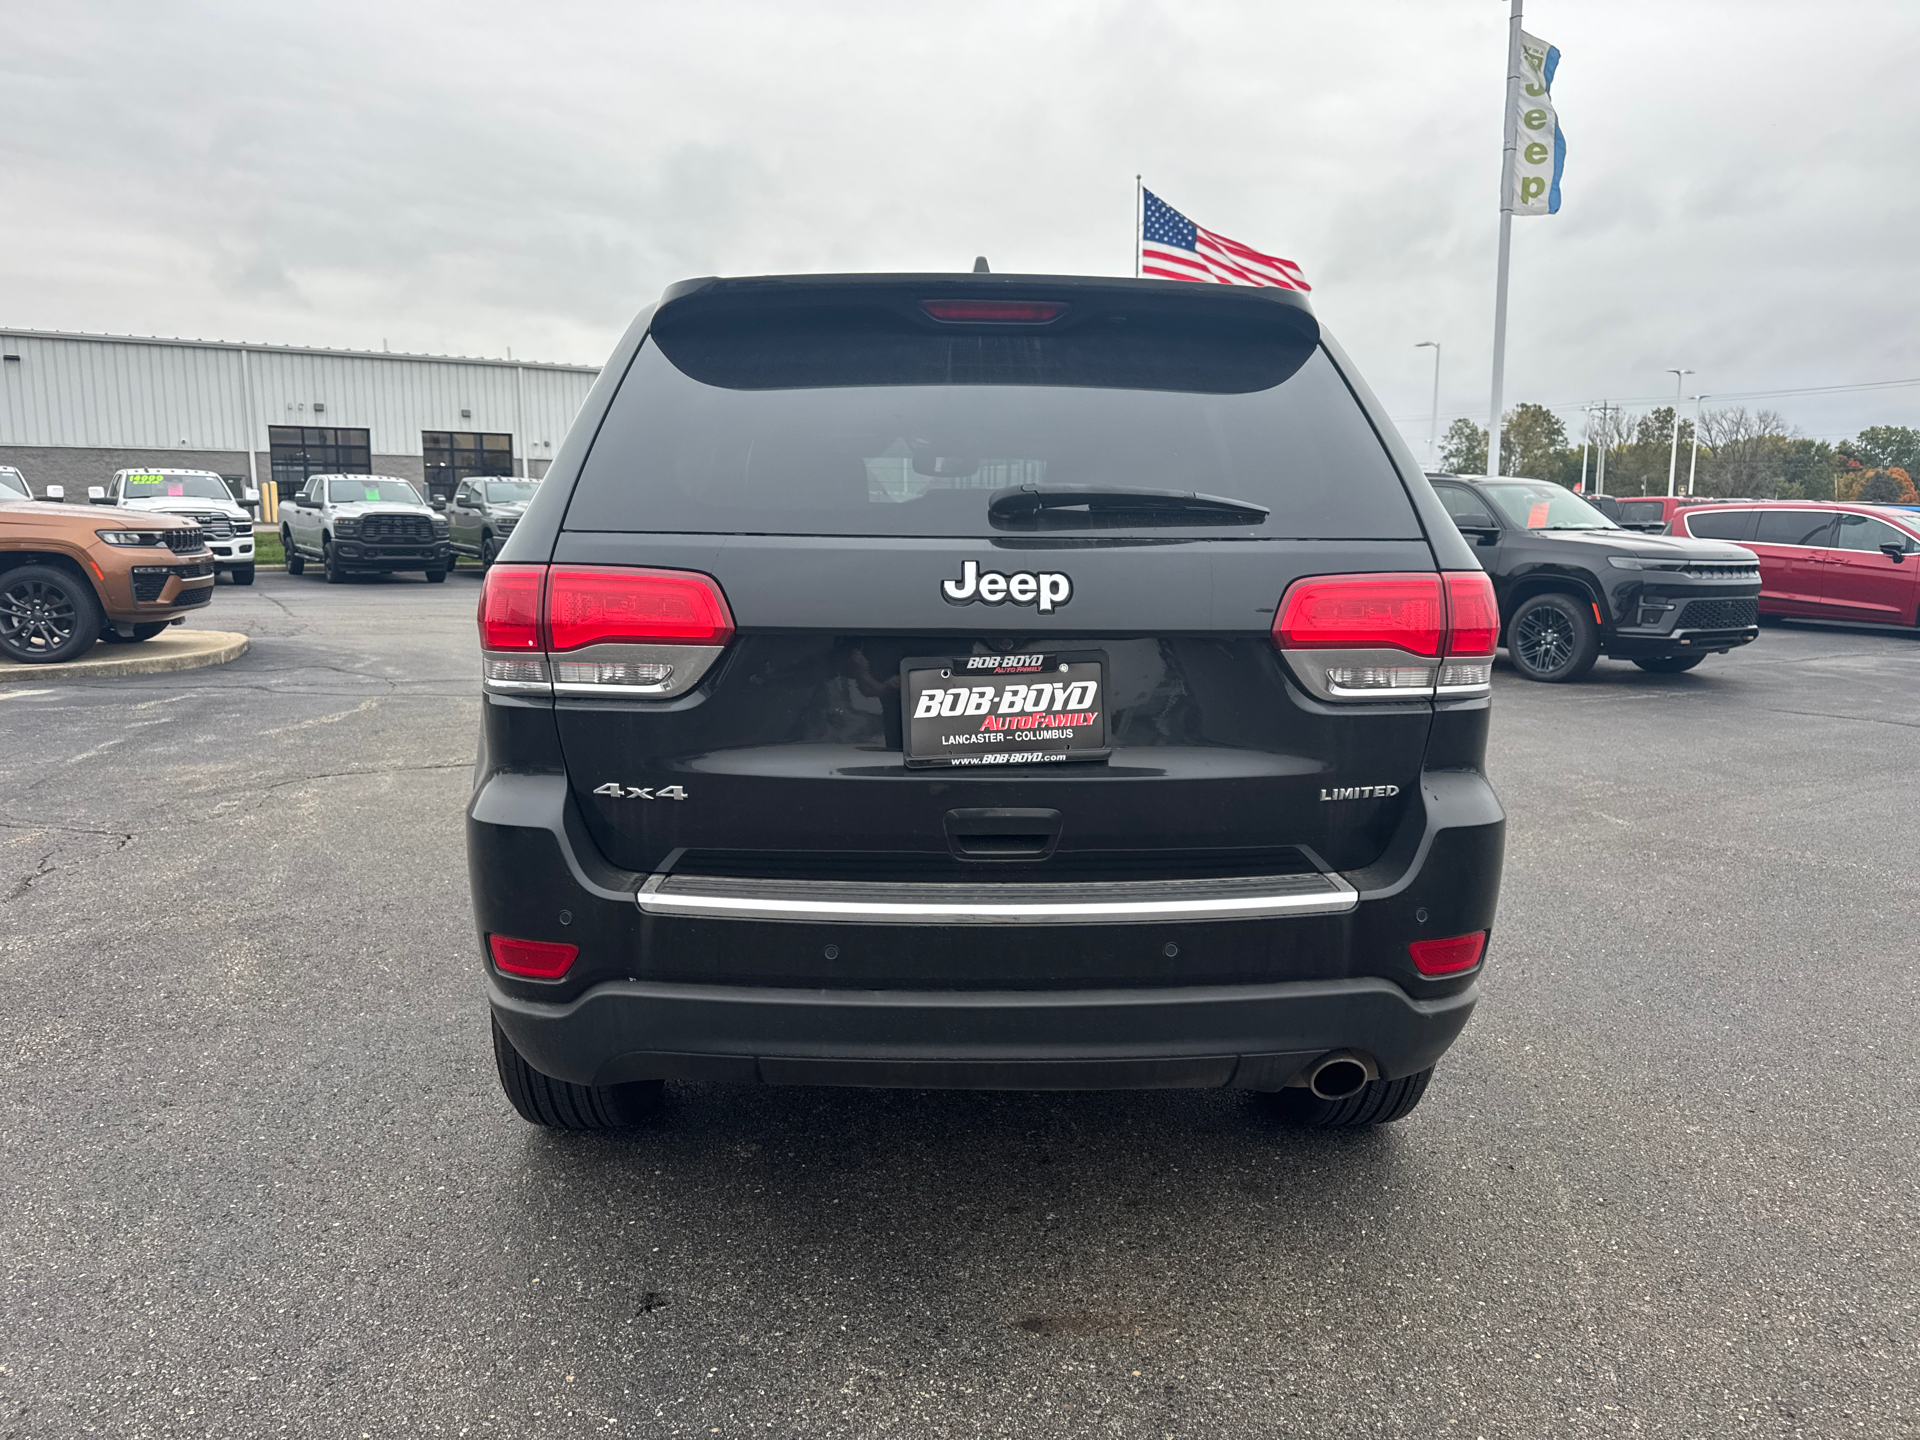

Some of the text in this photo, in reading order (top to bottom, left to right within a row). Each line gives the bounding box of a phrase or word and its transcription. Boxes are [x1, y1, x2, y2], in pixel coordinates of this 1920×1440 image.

[943, 560, 1070, 611] Jeep
[942, 733, 1004, 745] LANCASTER
[1015, 729, 1074, 741] COLUMBUS
[1320, 785, 1400, 801] LIMITED
